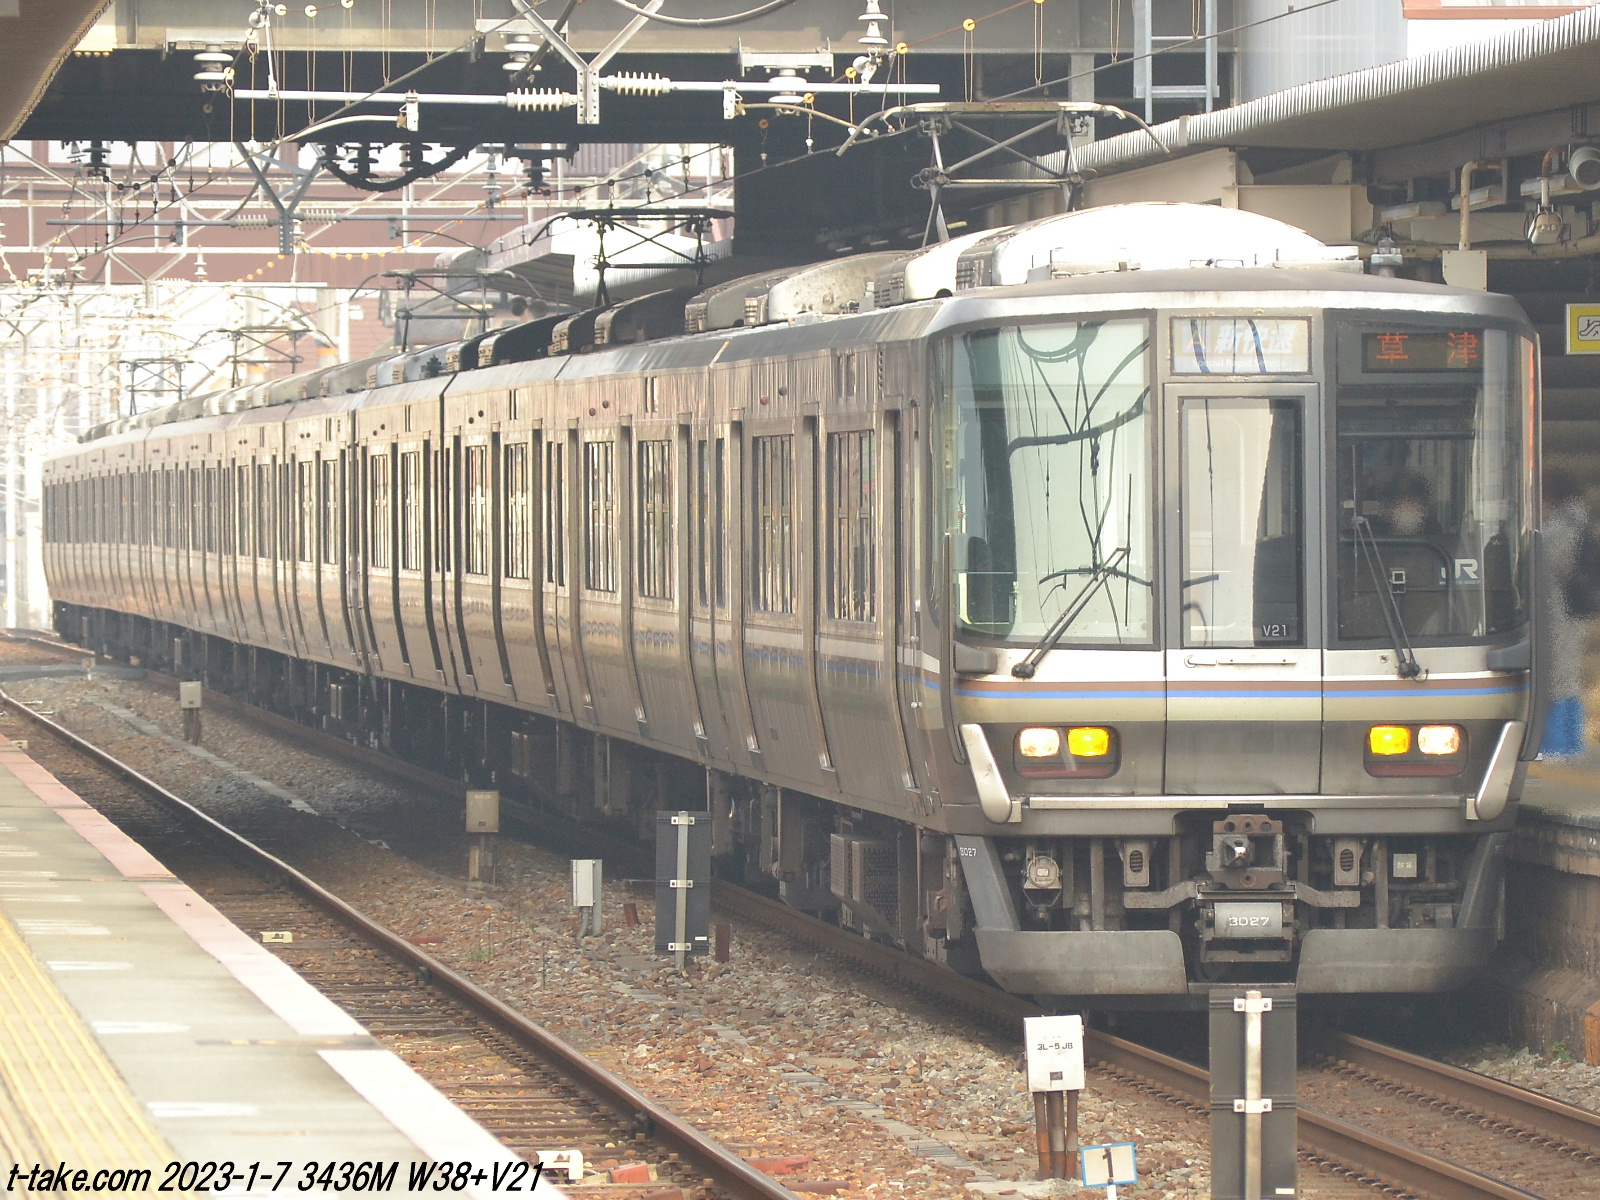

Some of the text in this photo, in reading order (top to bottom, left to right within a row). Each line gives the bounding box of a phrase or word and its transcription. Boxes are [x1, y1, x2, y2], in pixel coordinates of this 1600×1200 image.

[1214, 324, 1298, 354] 新快速
[1192, 358, 1286, 368] Special Rapid Service
[1262, 624, 1287, 637] V21
[959, 847, 977, 857] 3027
[1228, 916, 1270, 927] 3027
[1102, 1147, 1114, 1178] 1
